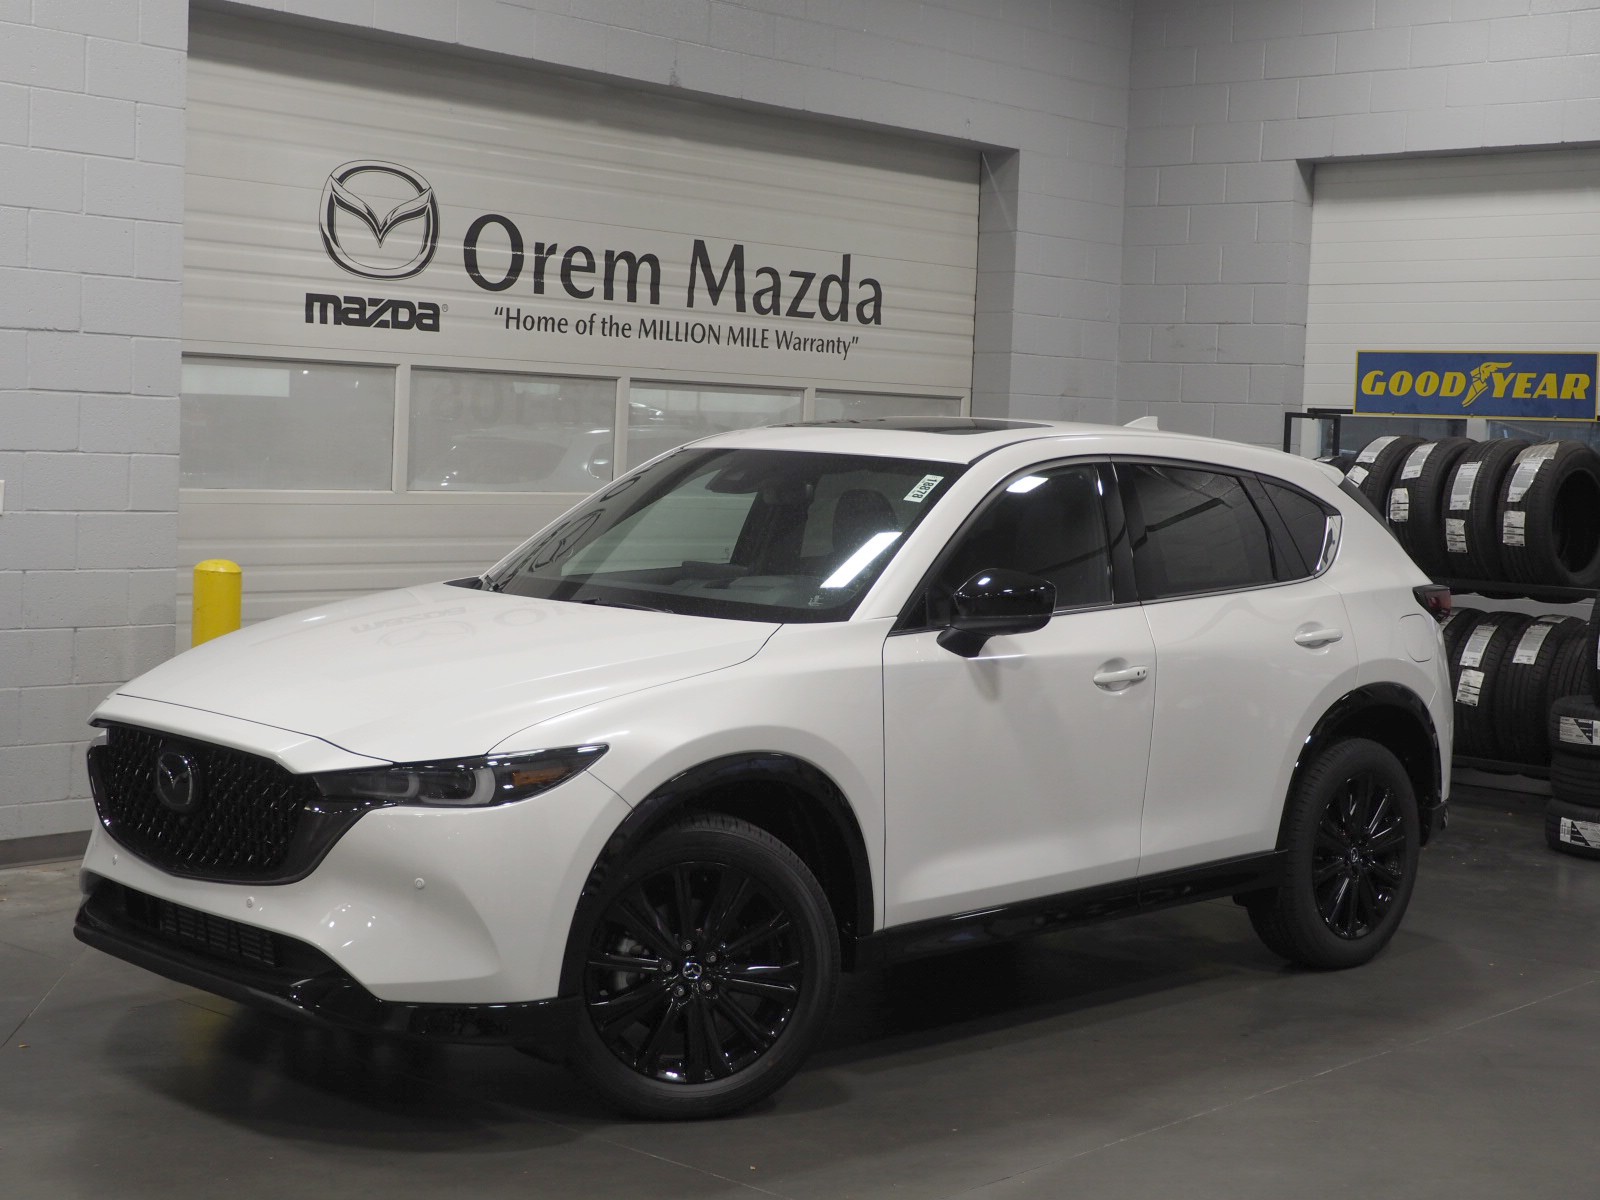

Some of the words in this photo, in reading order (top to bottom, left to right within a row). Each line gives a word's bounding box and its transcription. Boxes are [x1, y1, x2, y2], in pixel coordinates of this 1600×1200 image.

[463, 213, 661, 305] Orem
[686, 239, 883, 326] Mazda
[575, 313, 597, 336] of
[600, 315, 632, 339] the
[638, 318, 721, 346] MILLION
[727, 325, 769, 349] MILE
